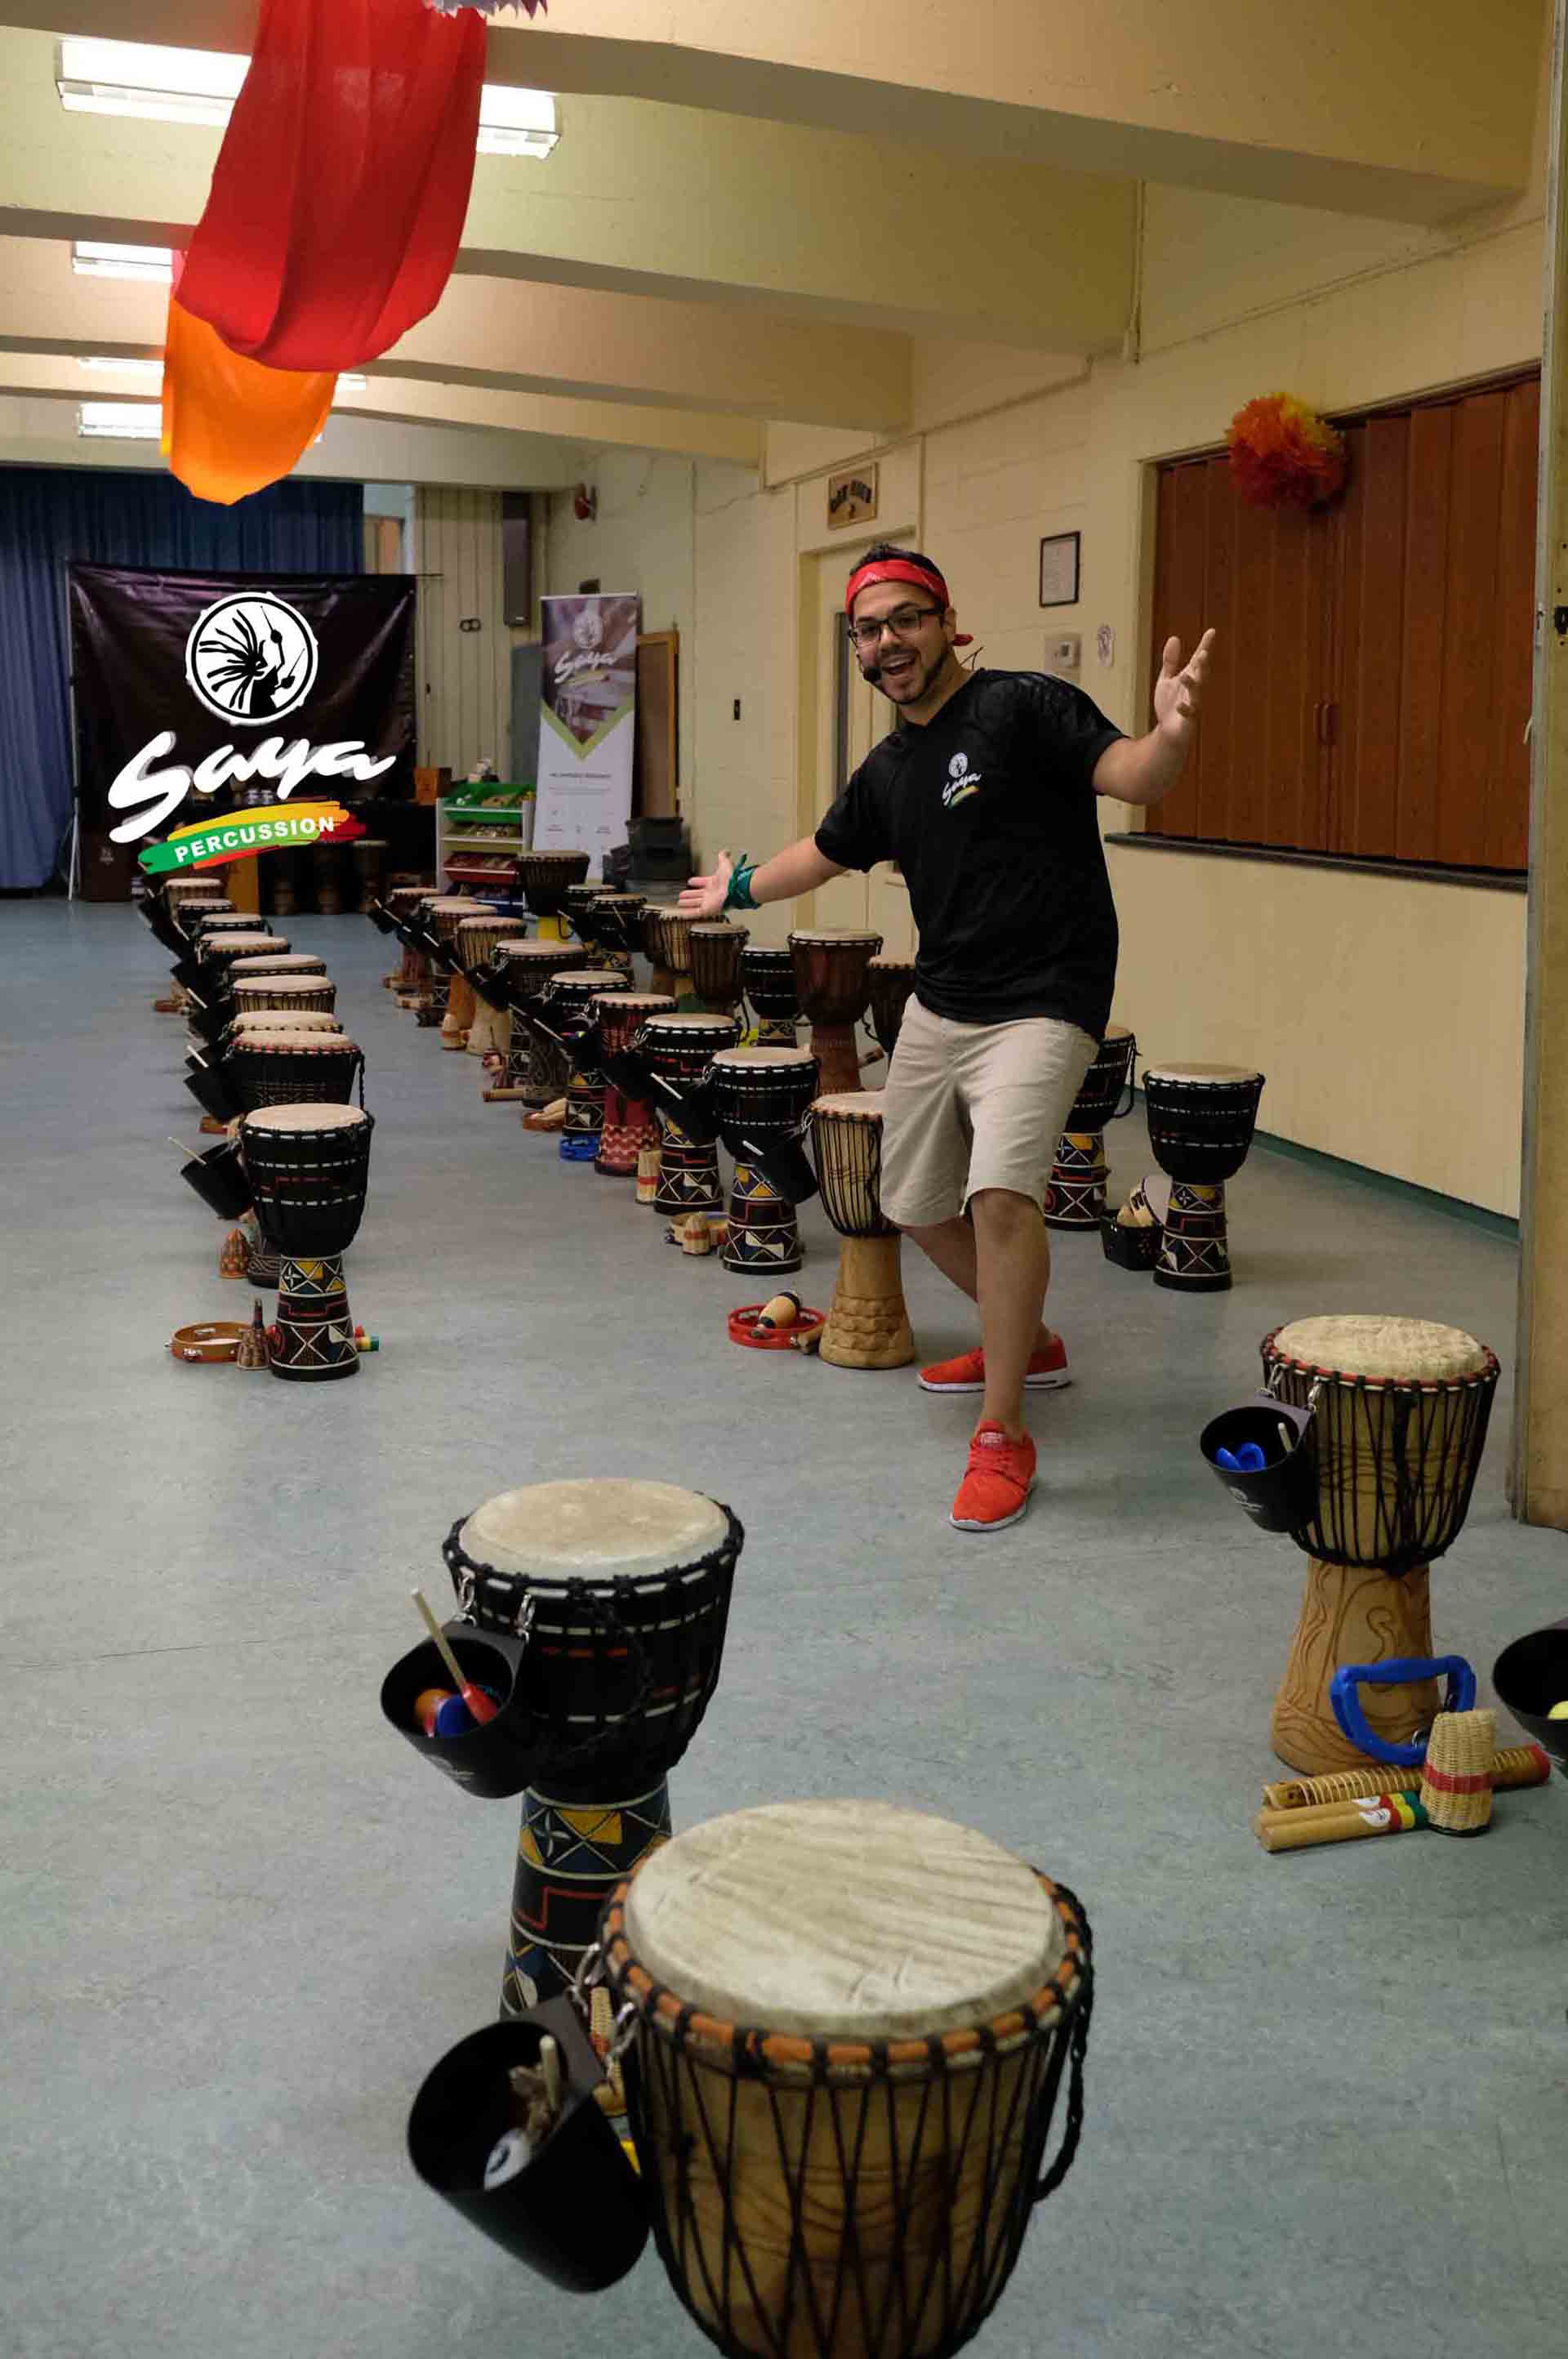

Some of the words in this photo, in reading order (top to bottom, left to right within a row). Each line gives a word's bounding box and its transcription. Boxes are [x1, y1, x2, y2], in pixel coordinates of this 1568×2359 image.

[108, 731, 397, 843] Saya
[942, 773, 982, 806] Saya
[174, 817, 335, 863] PERCUSSION
